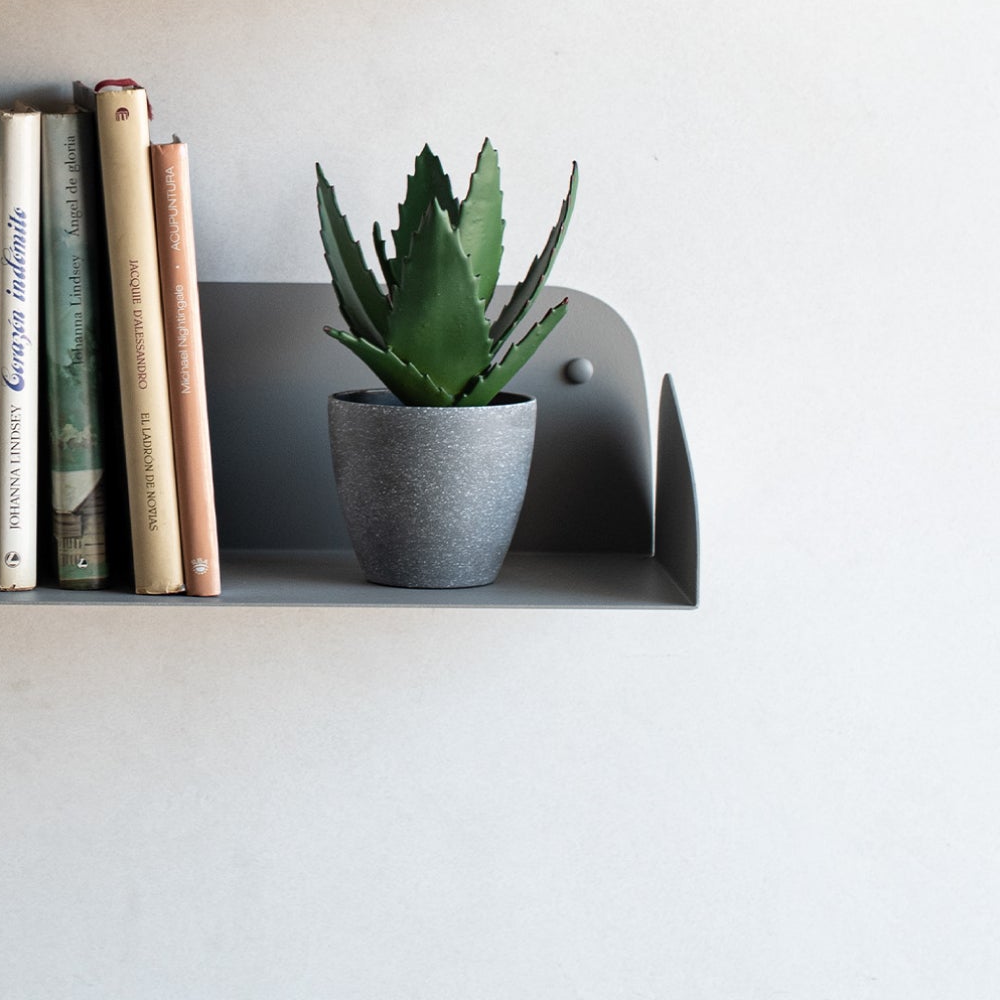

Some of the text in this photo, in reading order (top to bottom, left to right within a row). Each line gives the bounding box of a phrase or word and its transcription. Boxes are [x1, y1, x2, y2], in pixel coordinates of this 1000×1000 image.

[63, 135, 85, 306] Lindsey Ángel gloria
[164, 166, 192, 394] Michael Nightingale ACUPUNTURA
[2, 207, 31, 530] JOHANNA LINDSEY Corazón indómito
[129, 260, 148, 390] JACQUIE D'ALESSANDRO
[141, 428, 158, 531] LADRÓN NOVIAS
